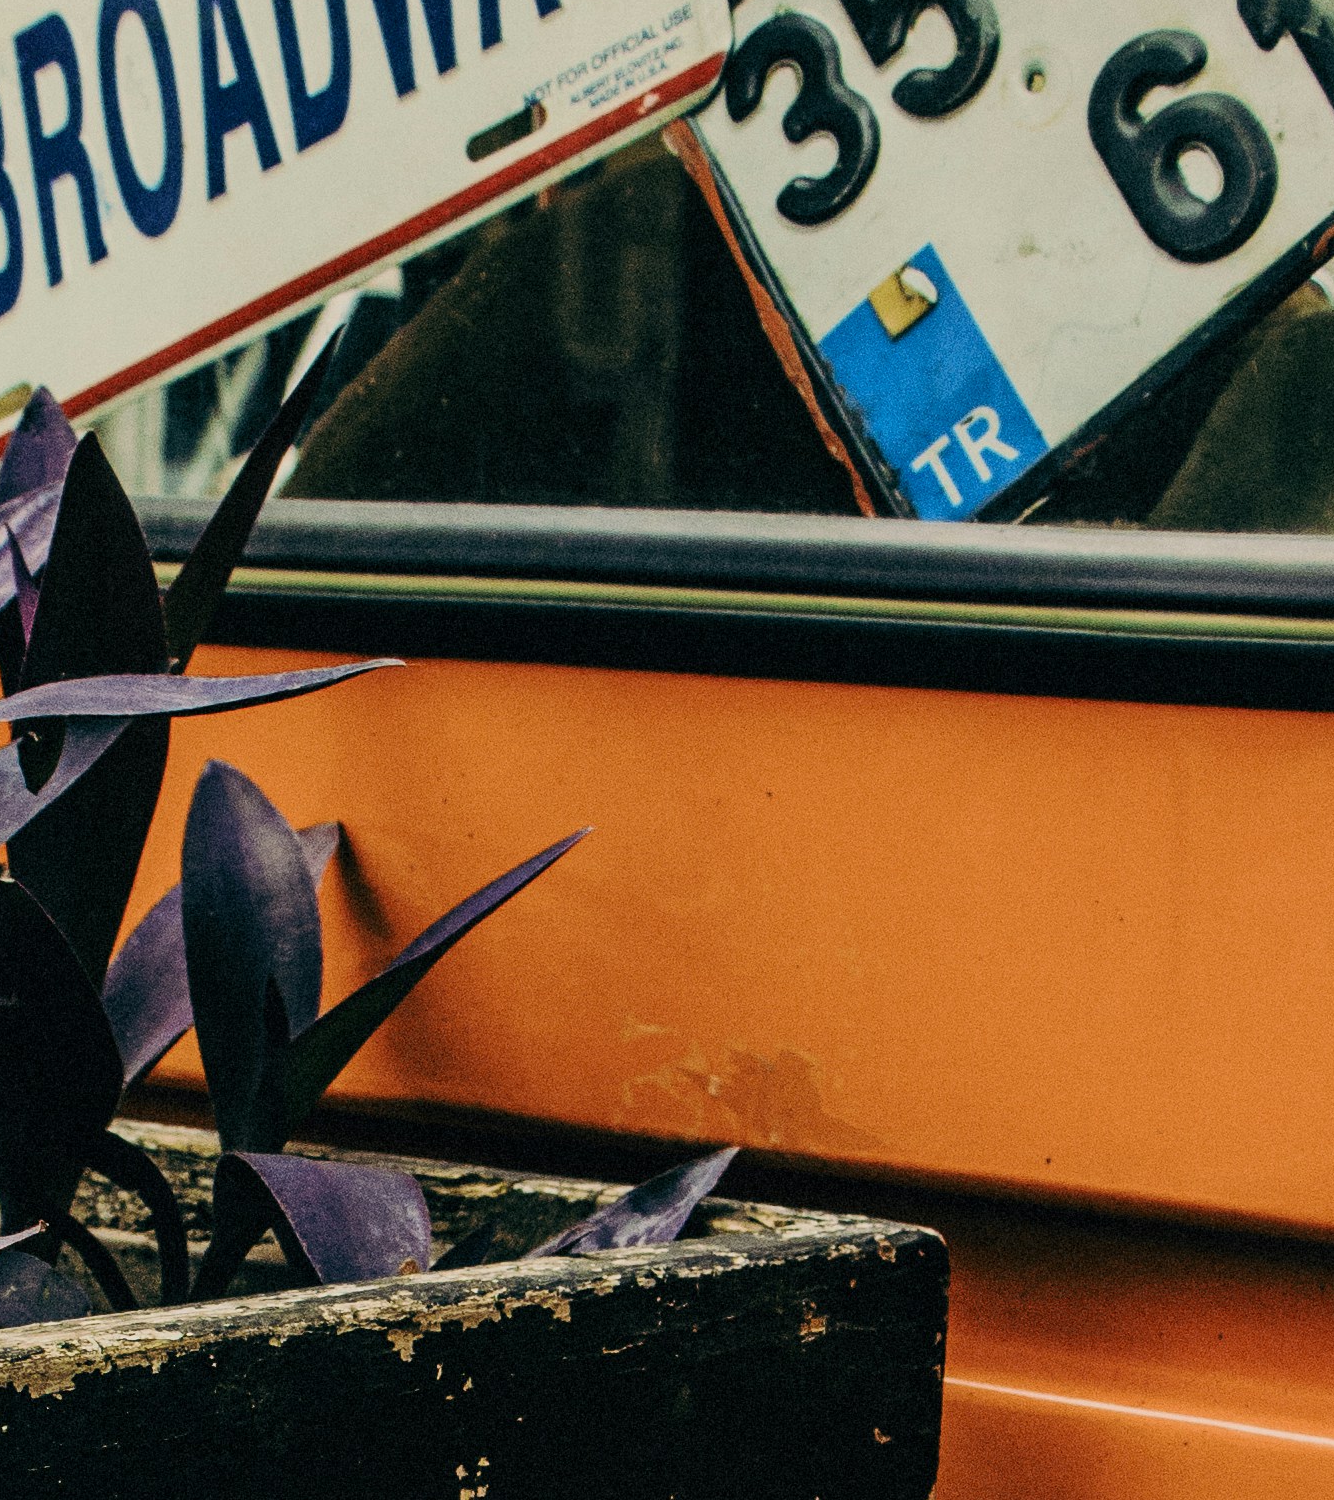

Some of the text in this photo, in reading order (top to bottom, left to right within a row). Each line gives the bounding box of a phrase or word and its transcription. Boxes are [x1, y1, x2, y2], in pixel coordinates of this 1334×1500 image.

[556, 61, 588, 88] FOR
[591, 24, 658, 71] OFFICIAL
[662, 3, 693, 31] USE
[910, 402, 1022, 508] TR
